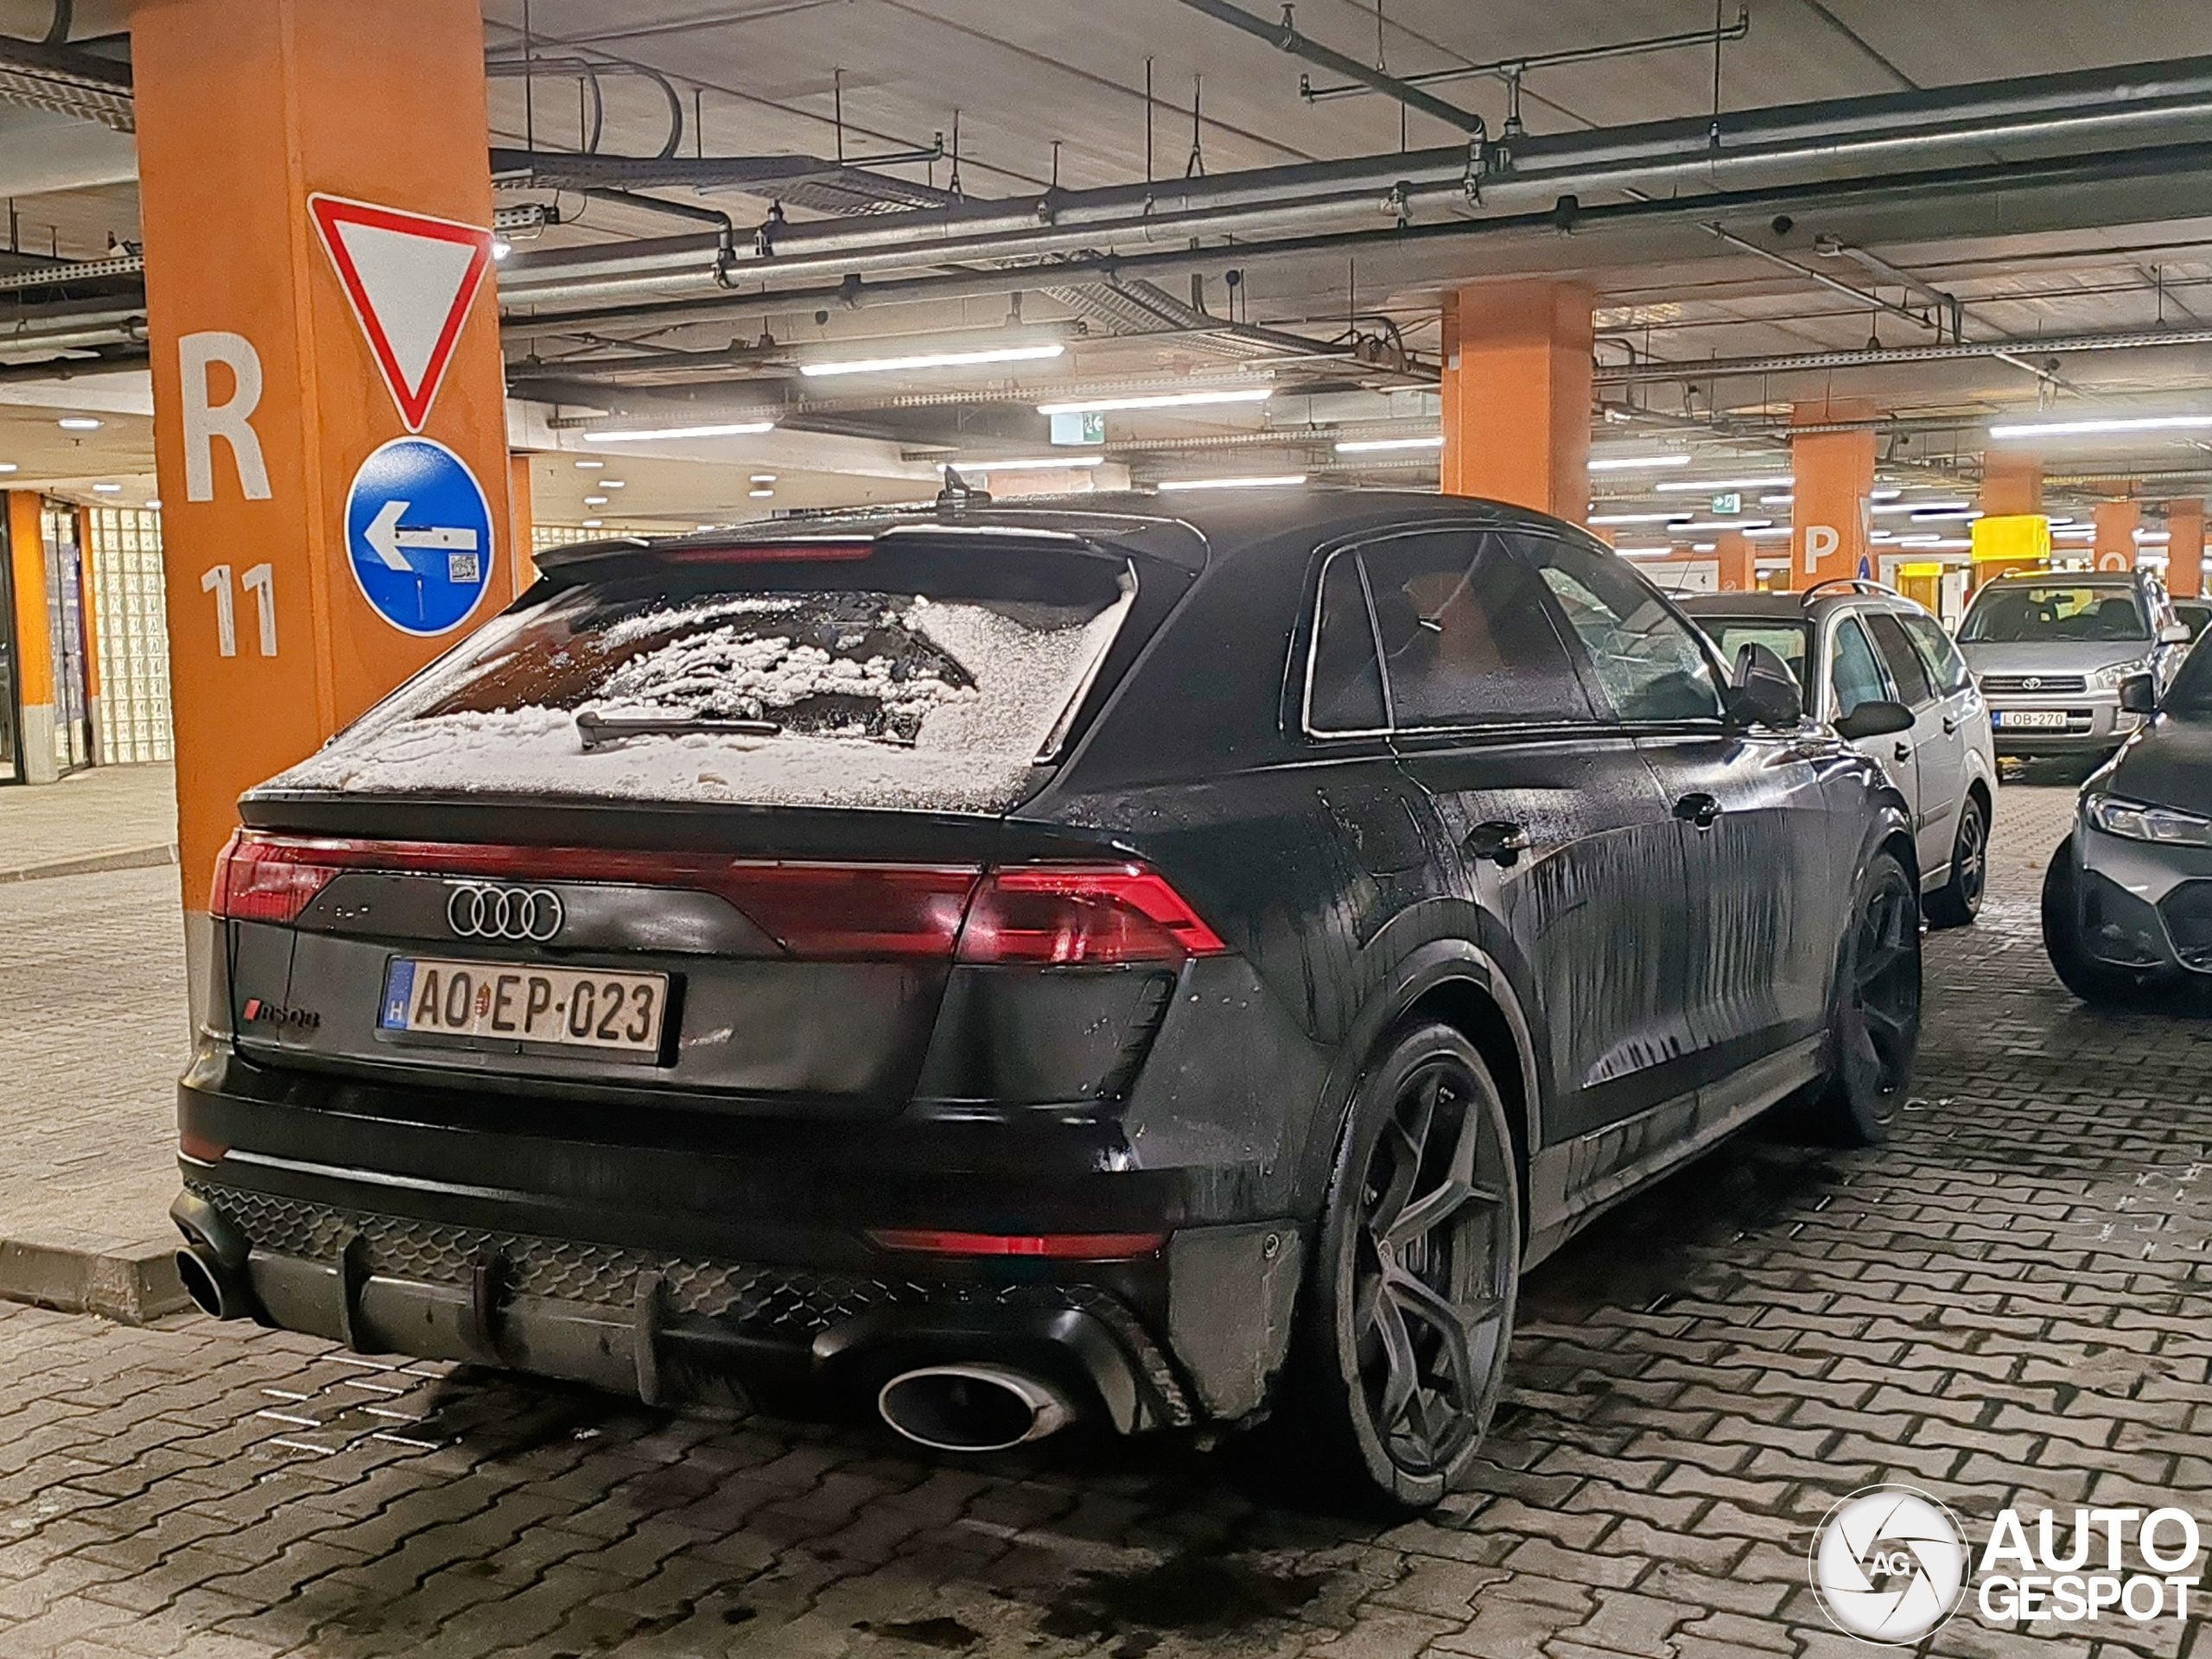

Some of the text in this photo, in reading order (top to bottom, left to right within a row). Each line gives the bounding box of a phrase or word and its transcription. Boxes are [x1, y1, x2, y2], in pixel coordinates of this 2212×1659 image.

[179, 331, 272, 502] R
[1805, 525, 1840, 574] P
[201, 563, 277, 657] 11
[2003, 714, 2063, 726] LOB-270
